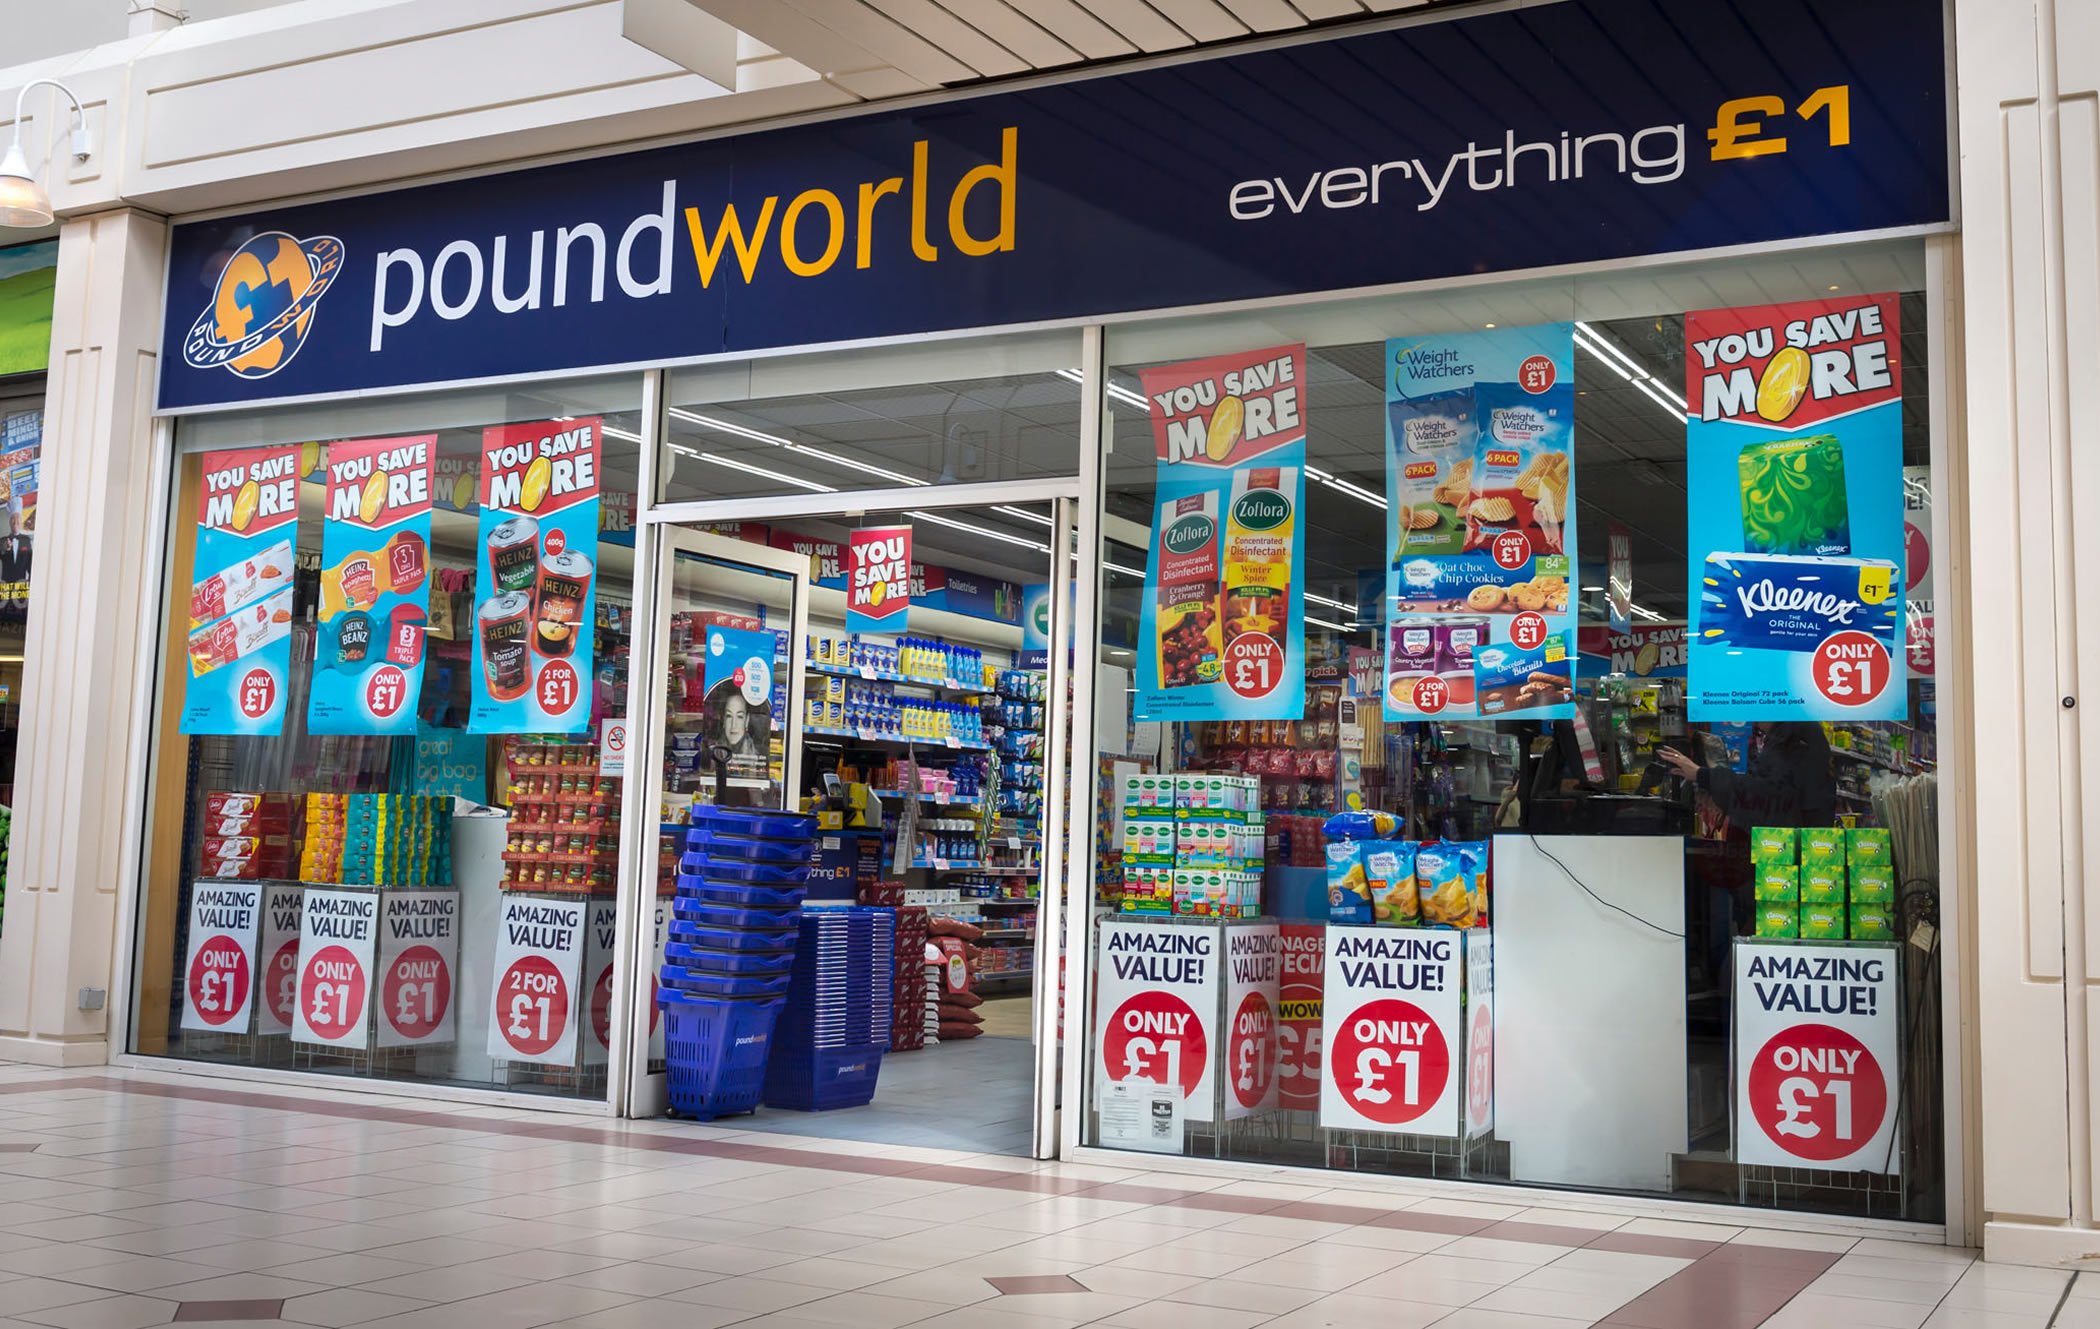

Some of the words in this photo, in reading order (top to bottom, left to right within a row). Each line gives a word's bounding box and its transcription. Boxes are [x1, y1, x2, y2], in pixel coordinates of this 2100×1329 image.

[1229, 122, 1686, 221] everything
[1706, 84, 1850, 162] £1
[370, 126, 1018, 353] poundworld
[187, 322, 264, 363] POUND
[1693, 326, 1775, 370] YOU
[1785, 304, 1884, 350] SAVE
[1407, 348, 1459, 367] Weight
[1525, 361, 1550, 371] ONLY
[1408, 363, 1475, 380] Watchers
[1527, 371, 1547, 387] £1
[1152, 378, 1217, 418] YOU
[1223, 354, 1295, 397] SAVE
[1702, 340, 1892, 423] MORE
[1166, 386, 1300, 466] MORE
[1413, 421, 1447, 433] Weight
[1501, 420, 1545, 432] Watchers
[1502, 412, 1536, 424] Weight
[1413, 429, 1458, 441] Watchers
[487, 440, 533, 472] YOU
[538, 426, 593, 459] SAVE
[331, 455, 372, 484] YOU
[377, 442, 428, 472] SAVE
[1487, 454, 1493, 462] 6
[1494, 454, 1519, 464] PACK
[205, 466, 246, 493] YOU
[249, 453, 295, 482] SAVE
[1406, 468, 1412, 476] 6
[1412, 464, 1436, 474] PACK
[489, 452, 596, 512] MORE
[205, 478, 296, 532] MORE
[331, 468, 428, 524] MORE
[1238, 500, 1284, 518] Zoflora
[546, 538, 564, 548] 400g
[1169, 525, 1209, 545] Zoflora
[1234, 536, 1283, 546] Concentrated
[1500, 538, 1524, 547] ONLY
[400, 548, 408, 564] 3
[499, 546, 534, 567] HEINZ
[793, 542, 814, 556] YOU
[815, 543, 838, 556] SAVE
[851, 535, 905, 567] YOU
[1230, 545, 1287, 557] Disinfectant
[1501, 547, 1520, 563] £1
[1610, 536, 1629, 559] YOU
[1815, 544, 1847, 554] Kleenex
[345, 562, 369, 578] HEINZ
[1166, 554, 1210, 570] Concentrated
[1240, 565, 1272, 575] Winter
[1439, 562, 1457, 573] Oat
[1459, 561, 1486, 572] Choc
[1545, 558, 1559, 570] 84
[499, 563, 536, 584] Vegetable
[854, 557, 908, 588] SAVE
[1163, 563, 1214, 581] Disinfectant
[1243, 574, 1268, 585] Spice
[1438, 573, 1463, 586] Chip
[1465, 573, 1505, 584] Cookies
[203, 579, 225, 603] Lotus
[544, 580, 580, 598] HEINZ
[854, 579, 909, 607] MORE
[948, 578, 978, 595] Toiletries
[1169, 583, 1205, 596] Cranberry
[1178, 589, 1205, 600] Orange
[1864, 584, 1877, 597] £1
[543, 600, 573, 615] Chicken
[1737, 578, 1860, 624] Kleenex
[346, 621, 365, 632] HEINZ
[489, 621, 524, 642] HEINZ
[1516, 617, 1541, 627] ONLY
[1769, 619, 1821, 631] ORIGINAL
[215, 623, 236, 645] Lotus
[342, 631, 368, 646] BEANZ
[404, 627, 411, 641] 3
[1518, 628, 1538, 644] £1
[1608, 633, 1644, 650] YOU
[394, 646, 414, 655] TRIPLE
[399, 654, 415, 664] PACK
[492, 647, 523, 662] Tomato
[1234, 643, 1273, 656] ONLY
[1826, 643, 1877, 659] ONLY
[500, 657, 517, 668] soup
[1313, 666, 1337, 677] pick
[1355, 656, 1370, 669] YOU
[1513, 660, 1543, 676] Biscuits
[246, 676, 271, 688] ONLY
[375, 674, 402, 685] ONLY
[545, 669, 551, 679] 2
[552, 669, 571, 680] FOR
[1235, 659, 1270, 689] £1
[1827, 661, 1872, 696] £1
[543, 680, 571, 706] £1
[1419, 682, 1425, 690] 2
[1427, 682, 1444, 691] FOR
[1731, 690, 1760, 698] Original
[245, 688, 268, 711] £1
[372, 686, 397, 711] £1
[1420, 690, 1441, 708] £1
[418, 737, 454, 759] great
[417, 759, 440, 782] big
[443, 759, 477, 782] bag
[836, 867, 850, 878] £1
[196, 890, 256, 908] AMAZING
[308, 897, 373, 918] AMAZING
[387, 899, 454, 916] AMAZING
[198, 908, 251, 930] VALUE!
[506, 904, 578, 928] AMAZING
[310, 916, 368, 941] VALUE!
[390, 918, 451, 939] VALUE!
[508, 923, 573, 951] VALUE!
[1107, 931, 1211, 956] AMAZING
[1230, 934, 1277, 956] AMAZING
[1334, 936, 1451, 962] AMAZING
[202, 949, 241, 969] ONLY
[314, 959, 357, 981] ONLY
[397, 961, 441, 980] ONLY
[1112, 954, 1205, 985] VALUE!
[1233, 957, 1275, 984] VALUE!
[1340, 961, 1444, 992] VALUE!
[1748, 955, 1884, 983] AMAZING
[200, 969, 235, 1012] £1
[510, 970, 521, 990] 2
[523, 973, 558, 994] FOR
[310, 981, 350, 1026] £1
[396, 982, 437, 1025] £1
[1754, 982, 1877, 1017] VALUE!
[507, 993, 550, 1041] £1
[1123, 1009, 1192, 1036] ONLY
[1238, 1010, 1269, 1036] ONLY
[735, 1032, 768, 1047] poundworld
[1353, 1018, 1431, 1046] ONLY
[838, 1063, 866, 1075] poundworld
[1121, 1036, 1183, 1086] £1
[1237, 1037, 1266, 1091] £1
[1773, 1045, 1862, 1076] ONLY
[1352, 1047, 1420, 1106] £1
[1774, 1076, 1852, 1141] £1
